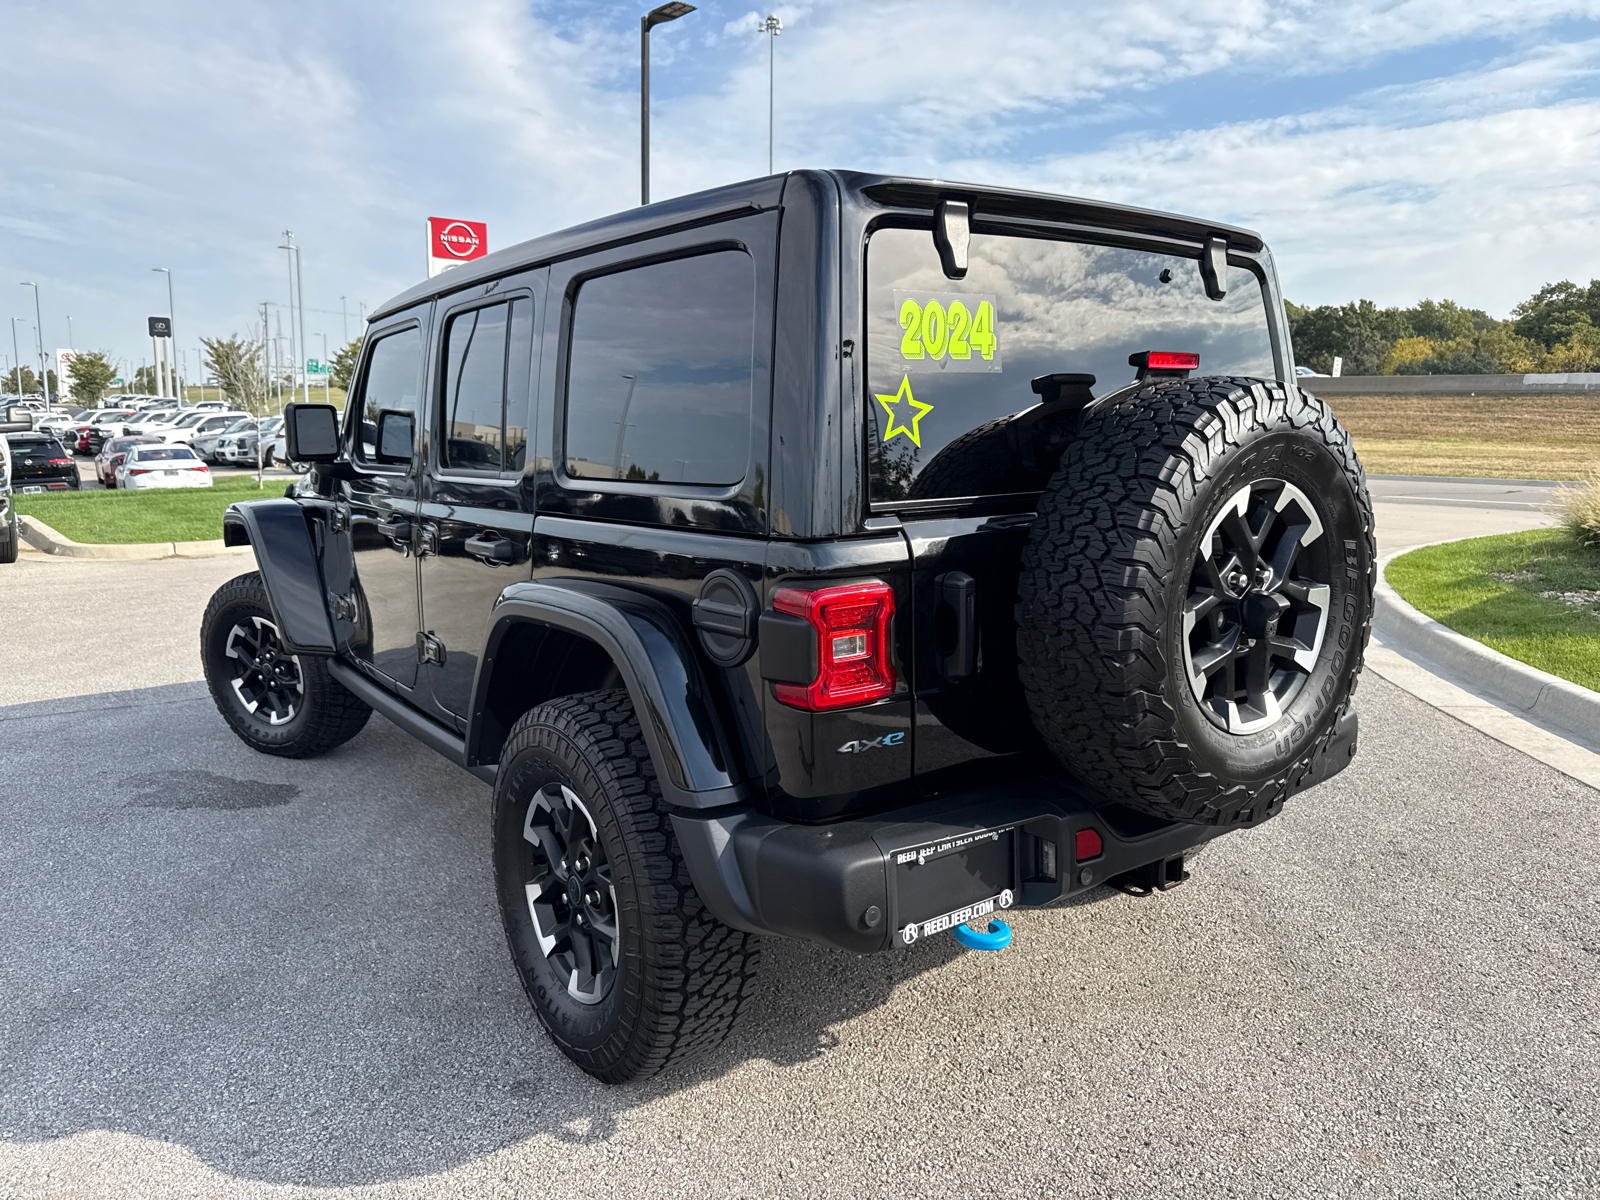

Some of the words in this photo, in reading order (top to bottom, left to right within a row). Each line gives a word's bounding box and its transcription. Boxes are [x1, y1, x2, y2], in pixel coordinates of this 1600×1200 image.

[440, 234, 479, 245] NISSAN
[899, 298, 997, 360] 2024
[1275, 539, 1360, 758] BFGoodrich
[897, 850, 917, 865] REED
[924, 899, 994, 937] REEDJEEP.COM
